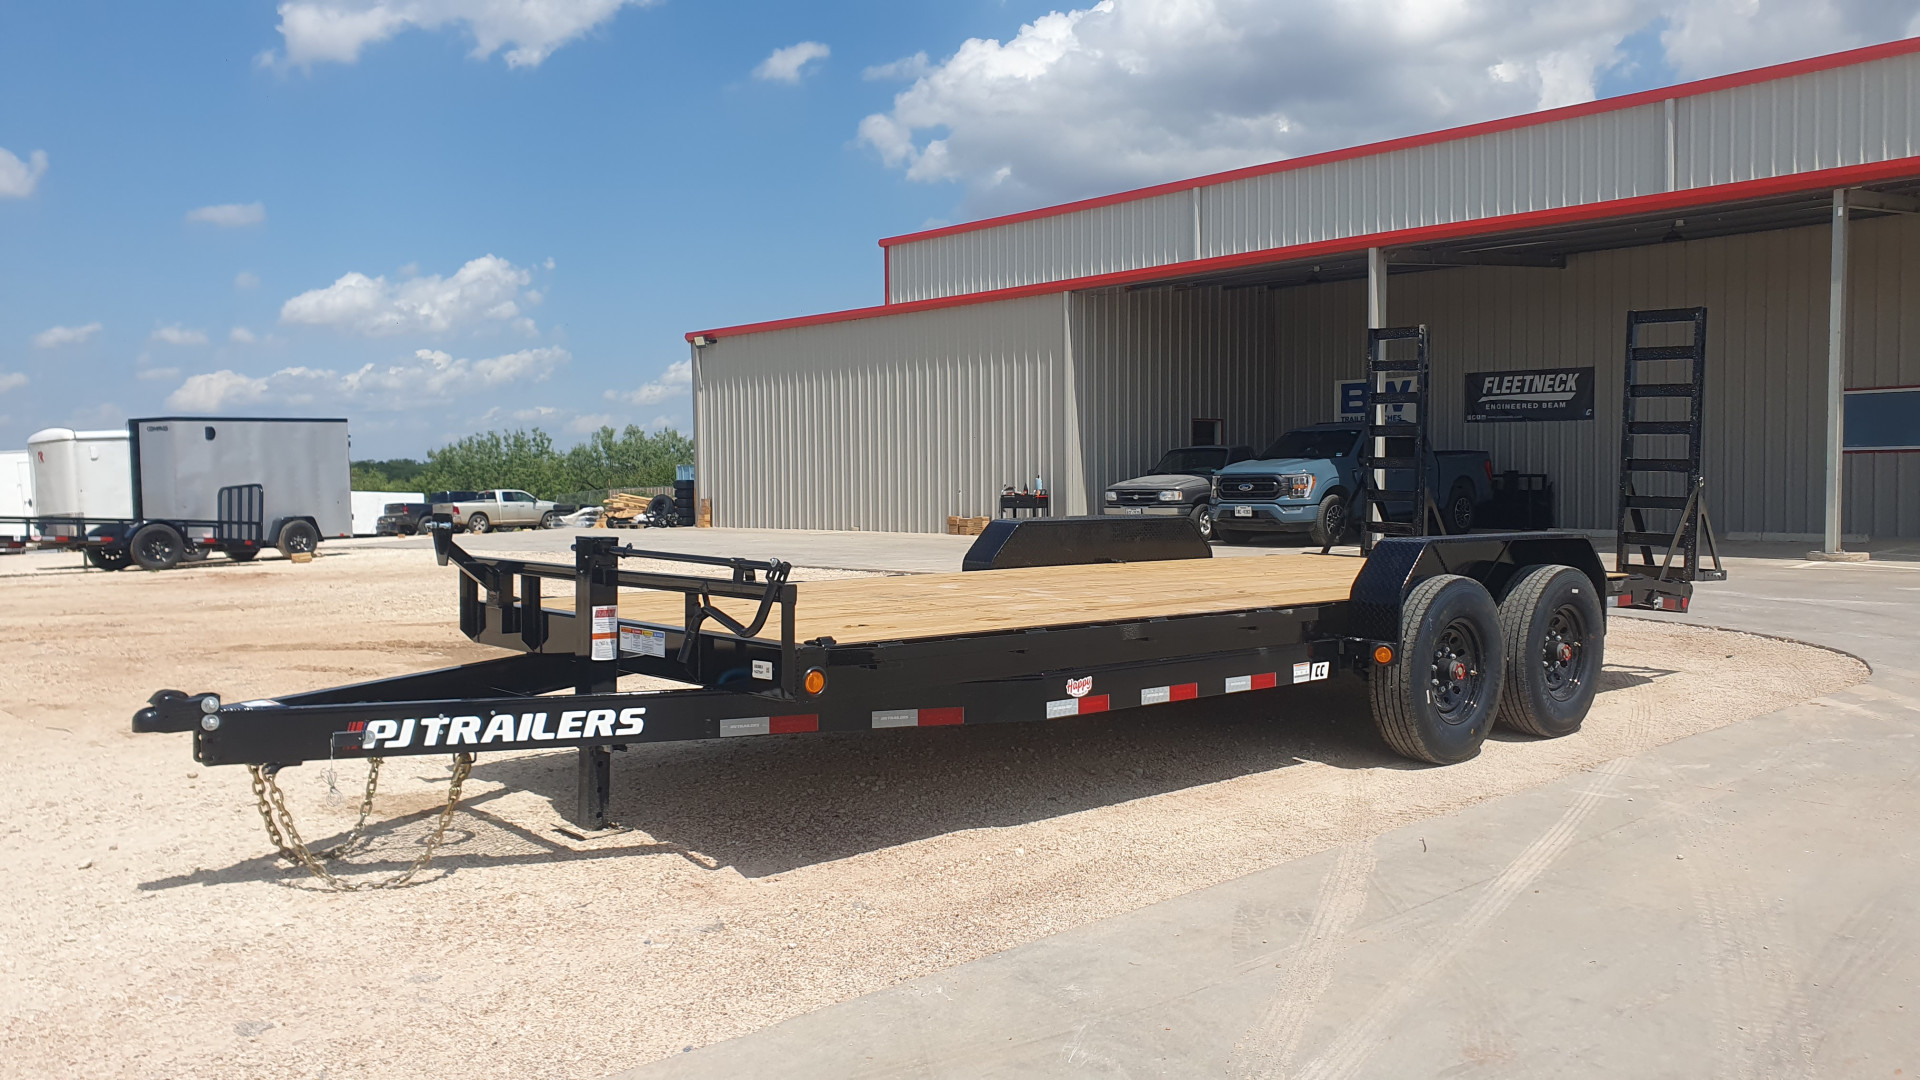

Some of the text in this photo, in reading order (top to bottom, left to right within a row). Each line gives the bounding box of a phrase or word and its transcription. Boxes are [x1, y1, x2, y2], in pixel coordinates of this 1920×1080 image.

[1482, 373, 1580, 394] FLEETNECK
[1315, 664, 1325, 677] CC
[1066, 677, 1092, 694] Happy
[362, 707, 647, 750] PJ TRAILERS
